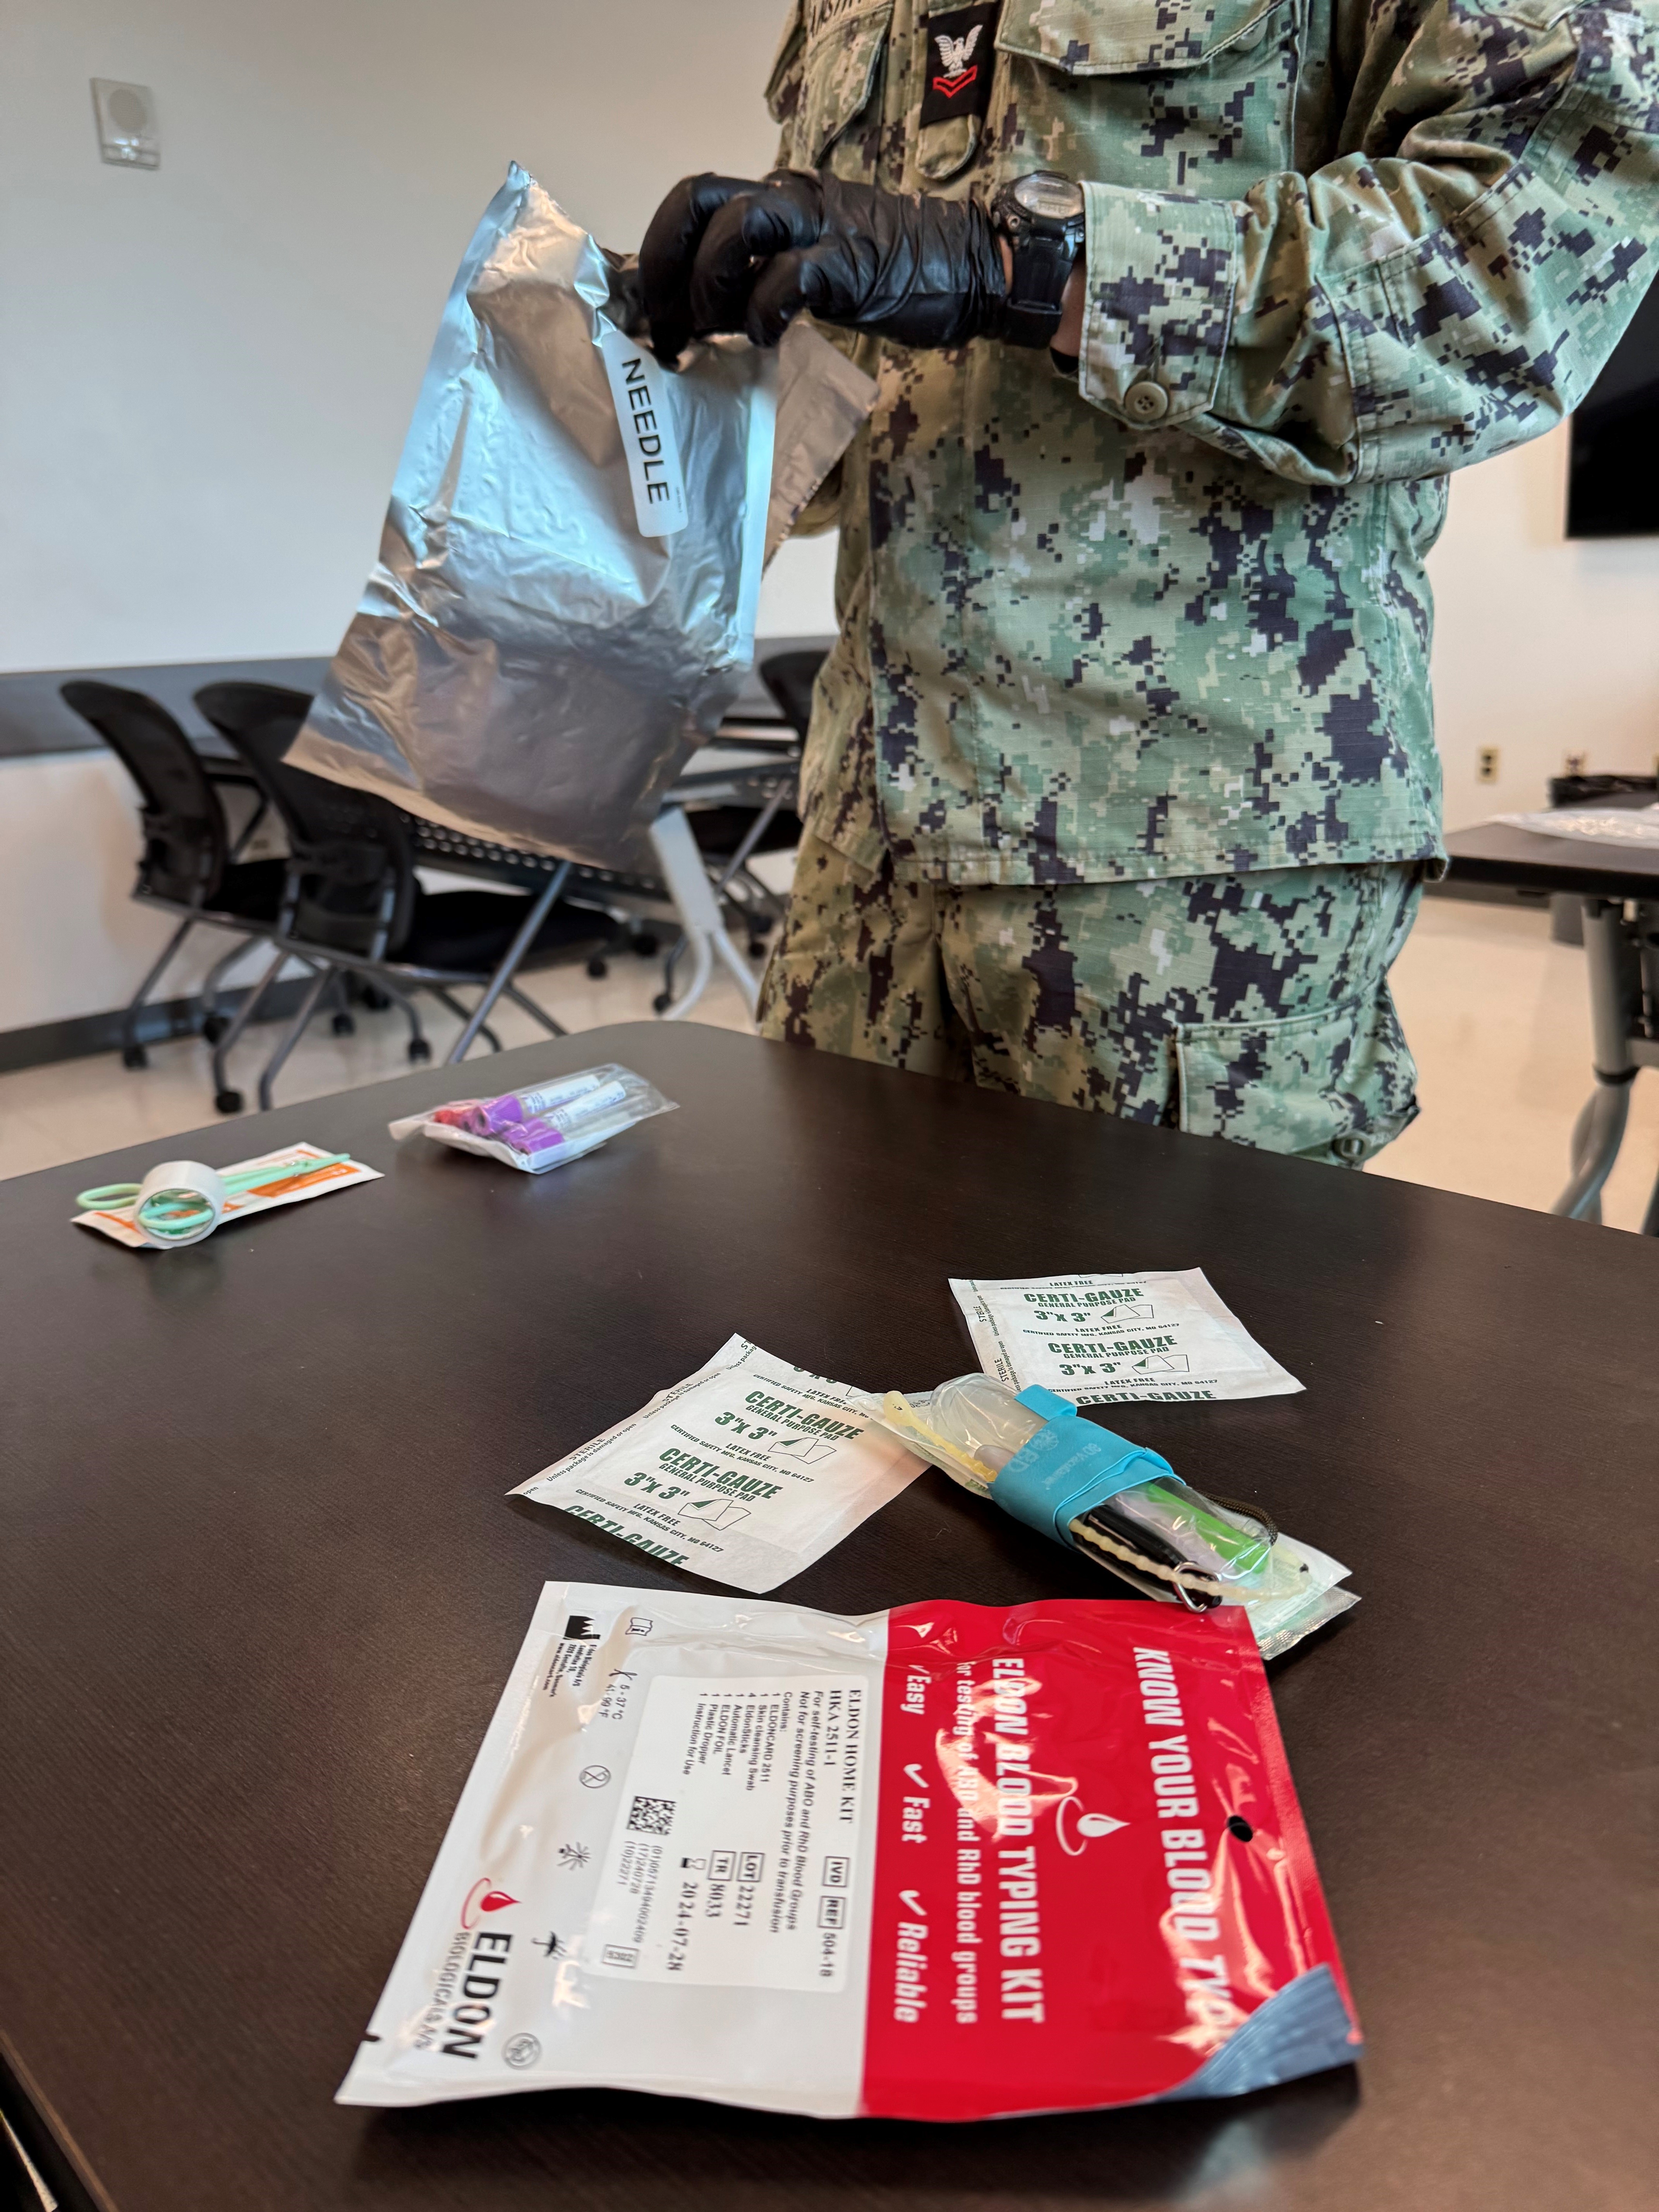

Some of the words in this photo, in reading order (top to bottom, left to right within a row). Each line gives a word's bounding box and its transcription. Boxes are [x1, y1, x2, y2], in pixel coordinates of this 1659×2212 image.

[622, 358, 670, 504] NEEDLE
[1024, 1288, 1144, 1302] CERTI-GAUZE
[1077, 1299, 1117, 1307] PURPOSE
[1048, 1335, 1178, 1353] CERTI-GAUZE
[1106, 1348, 1149, 1358] PURPOSE
[994, 1358, 1009, 1382] STERILE
[745, 1391, 865, 1439] CERTI-GAUZE
[1075, 1390, 1216, 1405] CERTI-GAUZE
[745, 1405, 782, 1423] GENERAL
[781, 1419, 821, 1437] PURPOSE
[819, 1432, 840, 1441] PAD
[748, 1427, 778, 1440] 3"
[546, 1469, 566, 1482] Unless
[565, 1455, 589, 1472] package
[593, 1436, 617, 1453] damaged
[623, 1423, 636, 1433] open
[569, 1438, 606, 1460] STERILE
[671, 1424, 699, 1443] CERTIFIED
[699, 1440, 723, 1452] SAFETY
[721, 1449, 735, 1458] MFG.
[737, 1456, 762, 1467] KANSAS
[762, 1463, 778, 1472] CITY,
[791, 1473, 814, 1482] 64127
[725, 1443, 750, 1456] LATEX
[749, 1452, 771, 1462] FREE
[659, 1448, 784, 1499] CERTI-GAUZE
[659, 1463, 696, 1482] GENERAL
[697, 1478, 738, 1496] PURPOSE
[735, 1491, 756, 1502] PAD
[658, 1486, 691, 1499] 3"
[575, 1489, 606, 1503] CERTIFIED
[605, 1501, 629, 1512] SAFETY
[644, 1516, 670, 1531] KANSAS
[699, 1542, 724, 1552] 64127
[633, 1503, 661, 1517] LATEX
[658, 1513, 681, 1526] FREE
[615, 1697, 627, 1707] 37
[799, 1691, 810, 1708] Not
[813, 1690, 824, 1708] For
[900, 1675, 931, 1715] Easy
[992, 1658, 1029, 1736] ELDON
[1133, 1647, 1184, 1726] KNOW
[705, 1704, 718, 1730] Plastic
[717, 1705, 730, 1733] ELDON
[756, 1705, 767, 1723] Skin
[779, 1692, 792, 1732] Contains:
[797, 1711, 808, 1725] for
[828, 1690, 842, 1721] HKA
[846, 1690, 861, 1740] ELDON
[952, 1680, 976, 1736] testing
[689, 1703, 706, 1745] Instruction
[728, 1704, 742, 1745] Automatic
[738, 1705, 755, 1753] EldonSticks
[763, 1704, 780, 1760] ELDONCARD
[805, 1710, 821, 1766] self-testing
[686, 1747, 697, 1758] for
[698, 1732, 713, 1764] Dropper
[713, 1735, 725, 1754] FOIL
[721, 1748, 737, 1775] Lancet
[748, 1725, 764, 1765] cleansing
[788, 1728, 804, 1778] screening
[824, 1726, 839, 1765] 2511-1
[957, 1742, 979, 1760] of
[683, 1760, 695, 1775] Use
[746, 1767, 758, 1791] Swab
[759, 1763, 771, 1782] 2511
[805, 1769, 816, 1781] of
[842, 1745, 858, 1791] HOME
[957, 1765, 979, 1801] ABO
[1148, 1735, 1199, 1819] YOUR
[784, 1779, 798, 1828] purposes
[803, 1782, 815, 1807] ABO
[995, 1743, 1034, 1836] BLOOD
[799, 1809, 811, 1829] and
[839, 1797, 854, 1824] KIT
[901, 1796, 930, 1844] Fast
[957, 1807, 981, 1842] and
[781, 1830, 793, 1854] prior
[797, 1831, 810, 1853] RhD
[716, 1858, 728, 1873] TR
[745, 1855, 758, 1879] LOT
[778, 1858, 790, 1868] to
[792, 1856, 807, 1886] Blood
[830, 1862, 843, 1883] IVD
[957, 1849, 982, 1885] RhD
[706, 1883, 726, 1918] 8033
[769, 1871, 788, 1933] transfusion
[998, 1846, 1042, 1958] TYPING
[1161, 1829, 1220, 1941] BLOOD
[733, 1885, 755, 1925] 22271
[785, 1889, 803, 1930] Groups
[824, 1899, 839, 1925] REF
[957, 1891, 983, 1944] blood
[893, 1921, 929, 2023] Reliable
[950, 1951, 978, 2024] groups
[441, 1932, 514, 2059] ELDON
[1000, 1968, 1045, 2024] KIT
